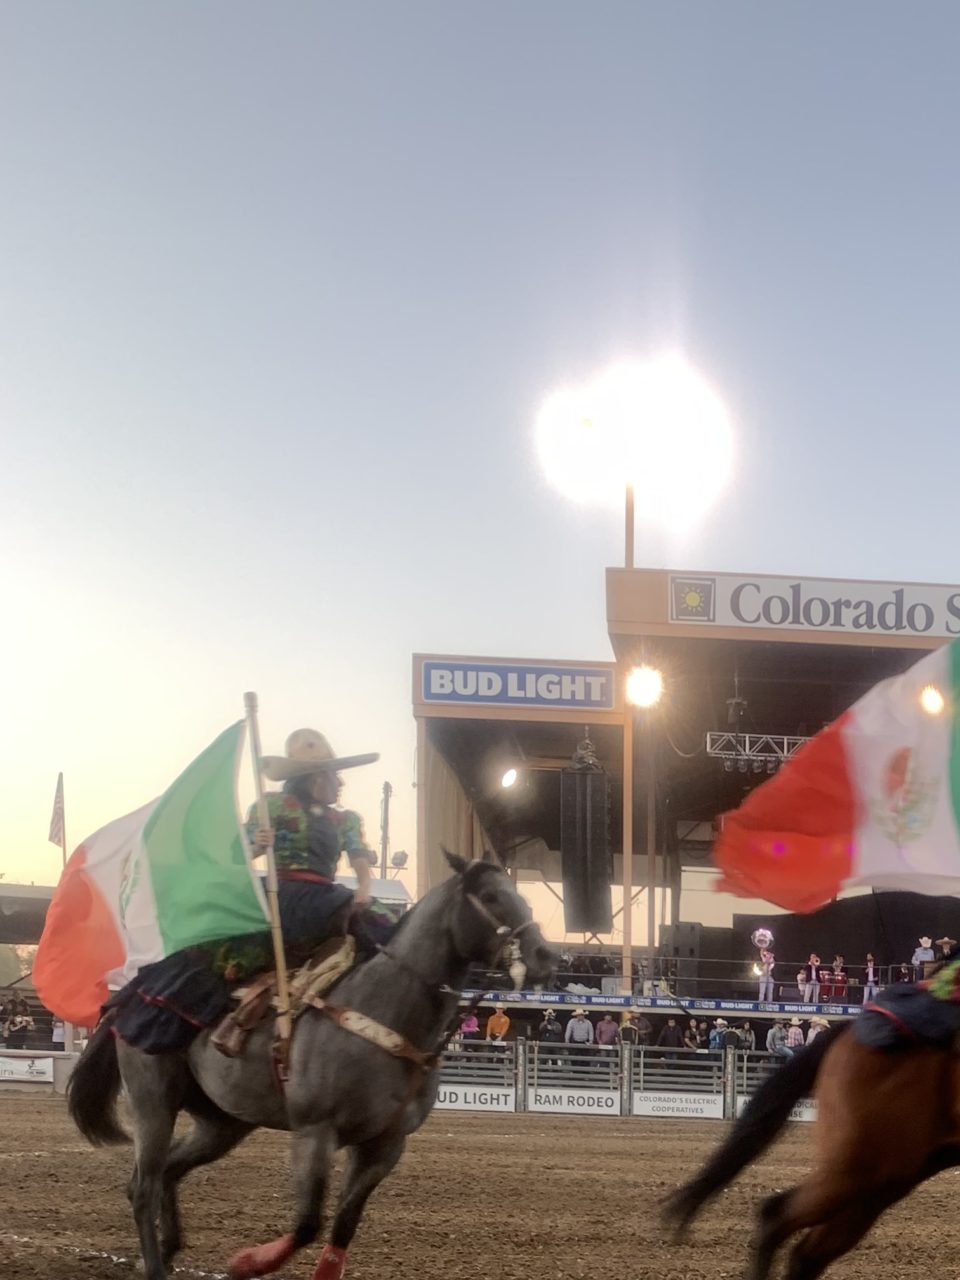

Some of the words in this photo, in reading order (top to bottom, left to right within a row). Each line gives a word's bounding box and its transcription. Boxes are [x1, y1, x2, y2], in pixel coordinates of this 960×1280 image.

[730, 582, 935, 632] Colorado
[430, 669, 502, 696] BUD
[507, 672, 607, 701] LIGHT
[437, 1091, 459, 1104] UD
[464, 1092, 511, 1106] LIGHT
[534, 1094, 563, 1106] RAM
[567, 1095, 615, 1108] RODEO
[639, 1095, 684, 1104] COLORADO'S
[685, 1097, 718, 1105] ELECTRIC
[651, 1105, 704, 1114] COOPERATIVES
